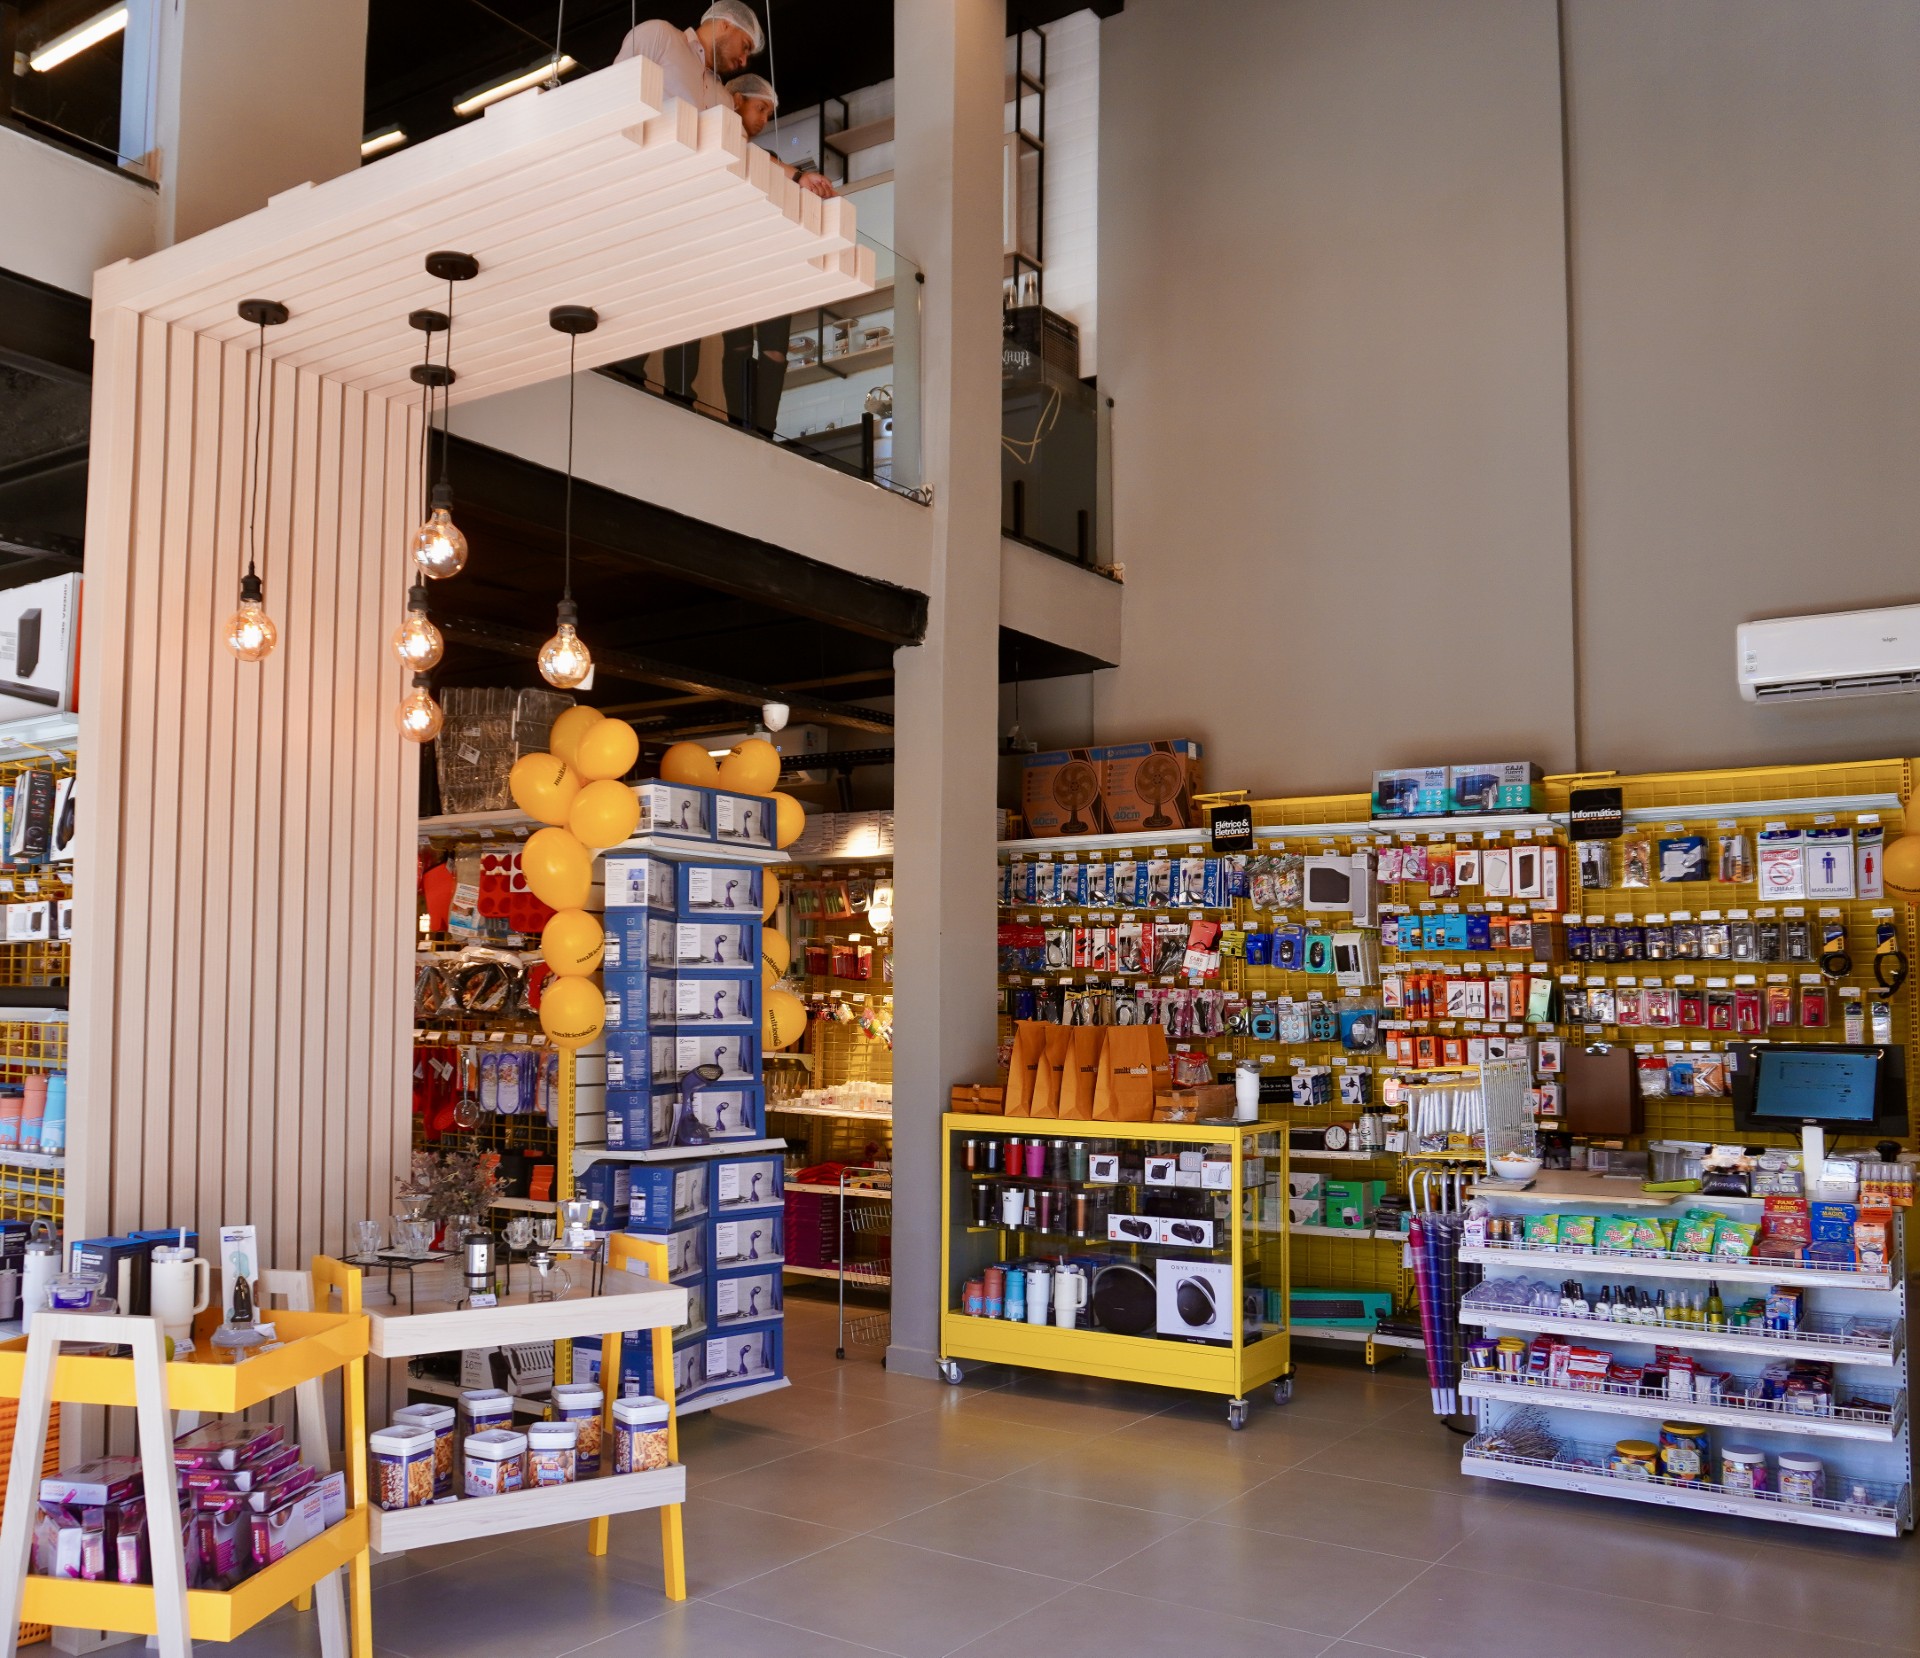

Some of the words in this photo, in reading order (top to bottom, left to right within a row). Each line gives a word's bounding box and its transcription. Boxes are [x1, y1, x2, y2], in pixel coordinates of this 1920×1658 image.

[1113, 811, 1140, 821] 40cm
[1571, 808, 1621, 819] Informática
[1215, 820, 1242, 829] Elétrico
[1242, 818, 1249, 827] &
[1215, 827, 1250, 836] Eletrônico
[1769, 885, 1795, 893] FUMAR
[1183, 1156, 1197, 1167] JBL
[464, 1361, 473, 1370] 16
